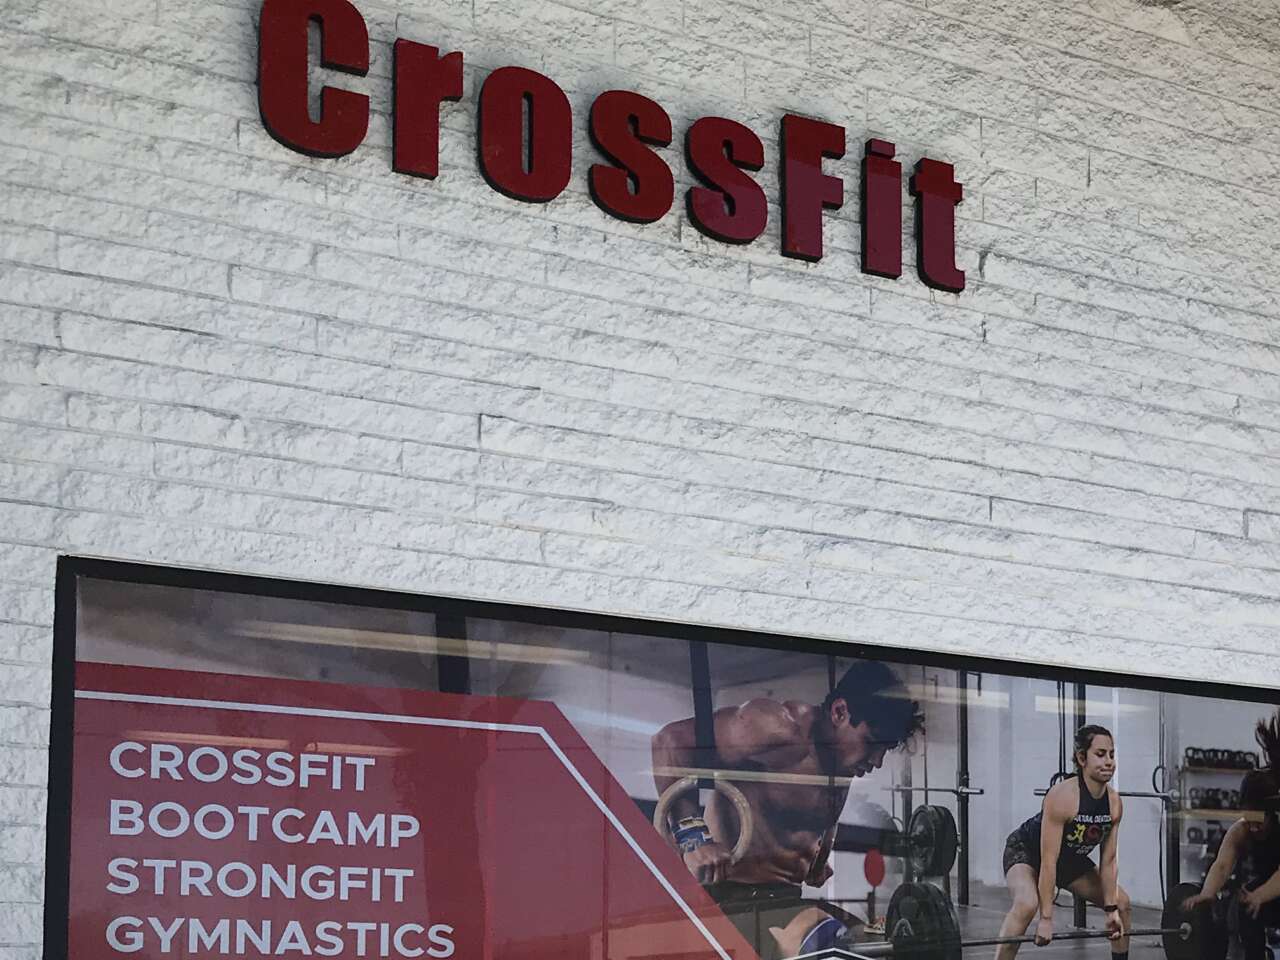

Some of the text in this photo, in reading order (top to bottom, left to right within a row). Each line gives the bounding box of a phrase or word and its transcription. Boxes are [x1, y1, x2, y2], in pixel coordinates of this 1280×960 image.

[257, 0, 966, 293] CrossFit
[109, 741, 376, 792] CROSSFIT
[108, 799, 420, 848] BOOTCAMP
[106, 857, 415, 903] STRONGFIT
[105, 916, 455, 958] GYMNASTICS
